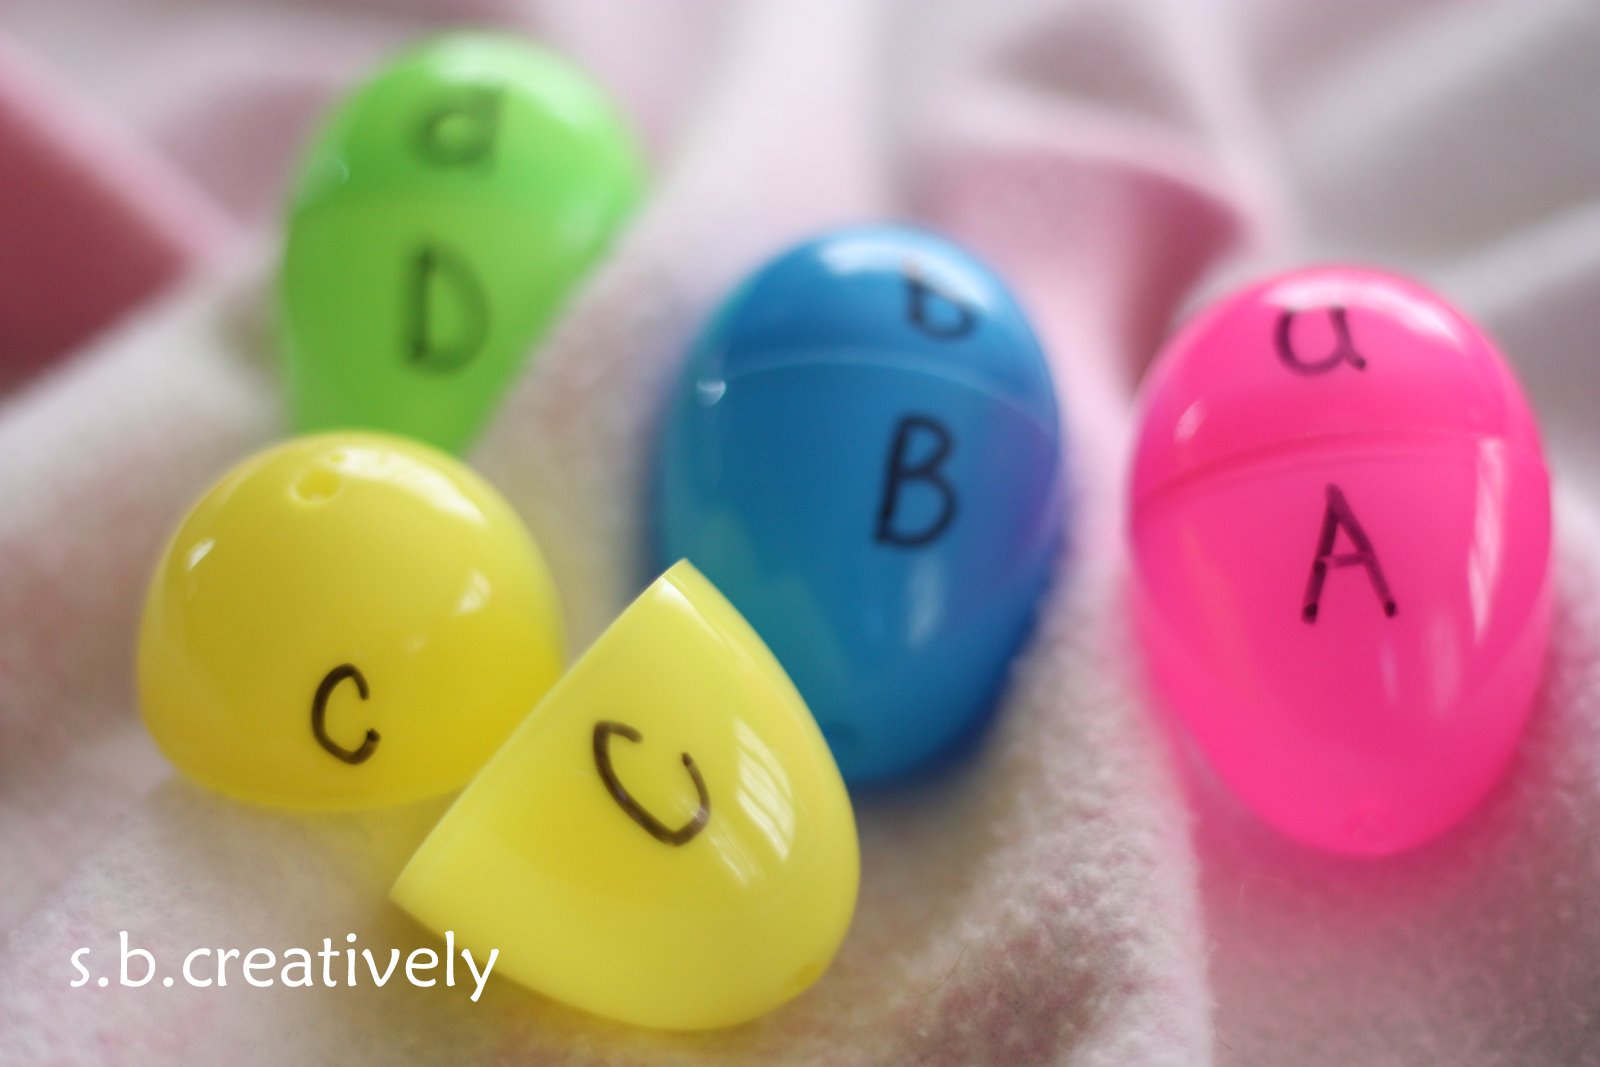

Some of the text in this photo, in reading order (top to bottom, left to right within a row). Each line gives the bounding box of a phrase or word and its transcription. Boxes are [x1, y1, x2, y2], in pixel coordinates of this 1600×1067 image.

[405, 244, 491, 373] D
[873, 413, 957, 550] B
[1300, 483, 1398, 622] A
